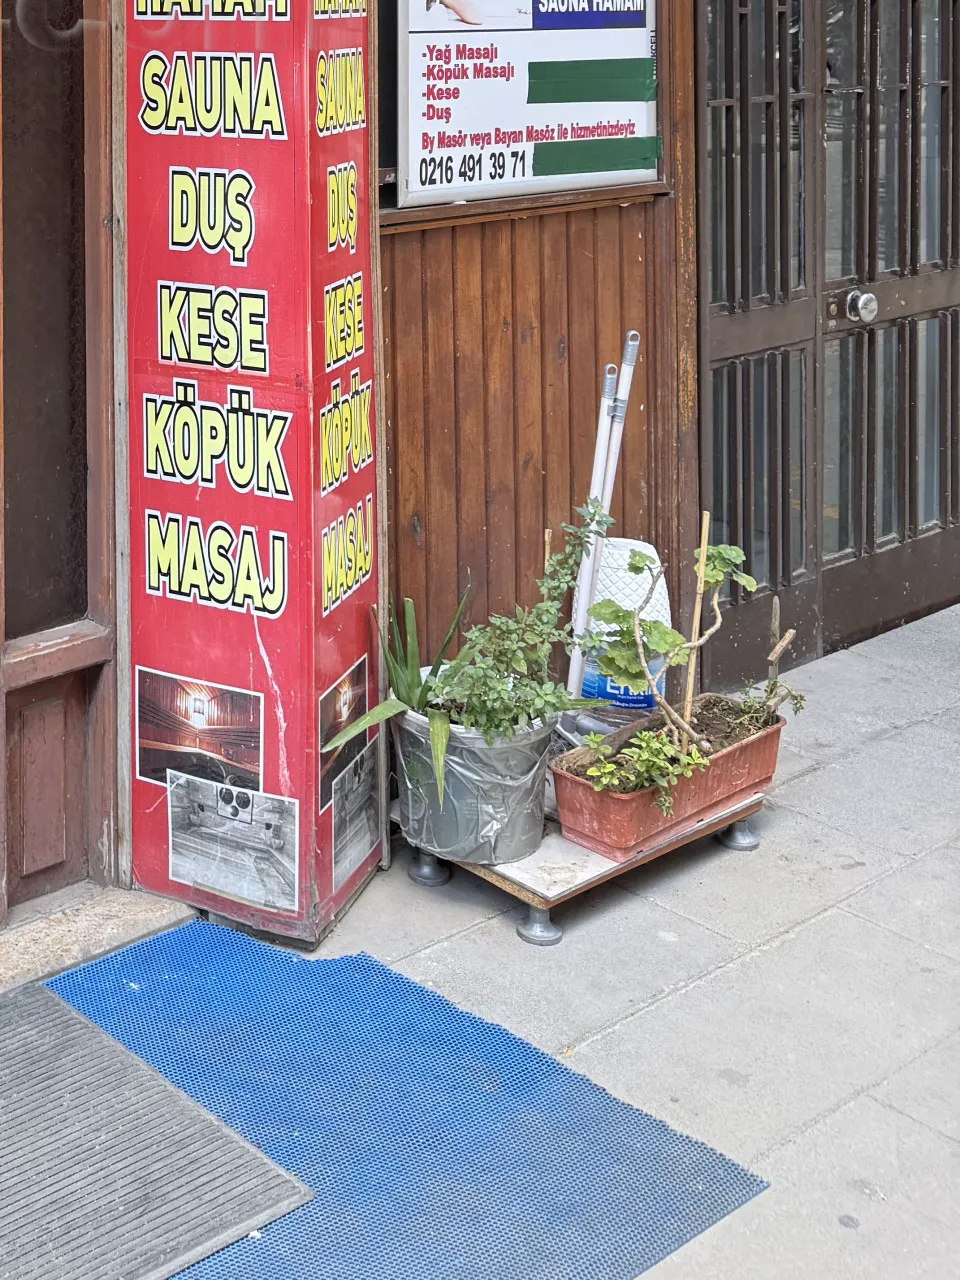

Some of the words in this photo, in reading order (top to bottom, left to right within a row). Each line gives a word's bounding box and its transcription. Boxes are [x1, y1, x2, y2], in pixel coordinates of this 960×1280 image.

[140, 52, 287, 140] SAUNA
[317, 48, 366, 137] SAUNA
[422, 132, 435, 154] By
[437, 129, 467, 149] Masör
[469, 132, 491, 150] veya
[494, 127, 523, 148] Bayan
[526, 125, 555, 143] Masöz
[557, 123, 568, 141] ile
[571, 119, 636, 140] hizmetinizdeyiz
[328, 161, 358, 254] DUŞ
[419, 156, 454, 186] 0216
[459, 153, 483, 182] 491
[489, 152, 506, 180] 39
[511, 150, 526, 178] 71
[170, 168, 254, 265] DUŞ
[158, 282, 269, 375] KESE
[324, 272, 364, 372] KESE
[144, 379, 292, 499] KÖPÜK
[321, 369, 372, 497] KÖPÜK
[145, 511, 287, 618] MASAJ
[322, 494, 373, 617] MASAJ
